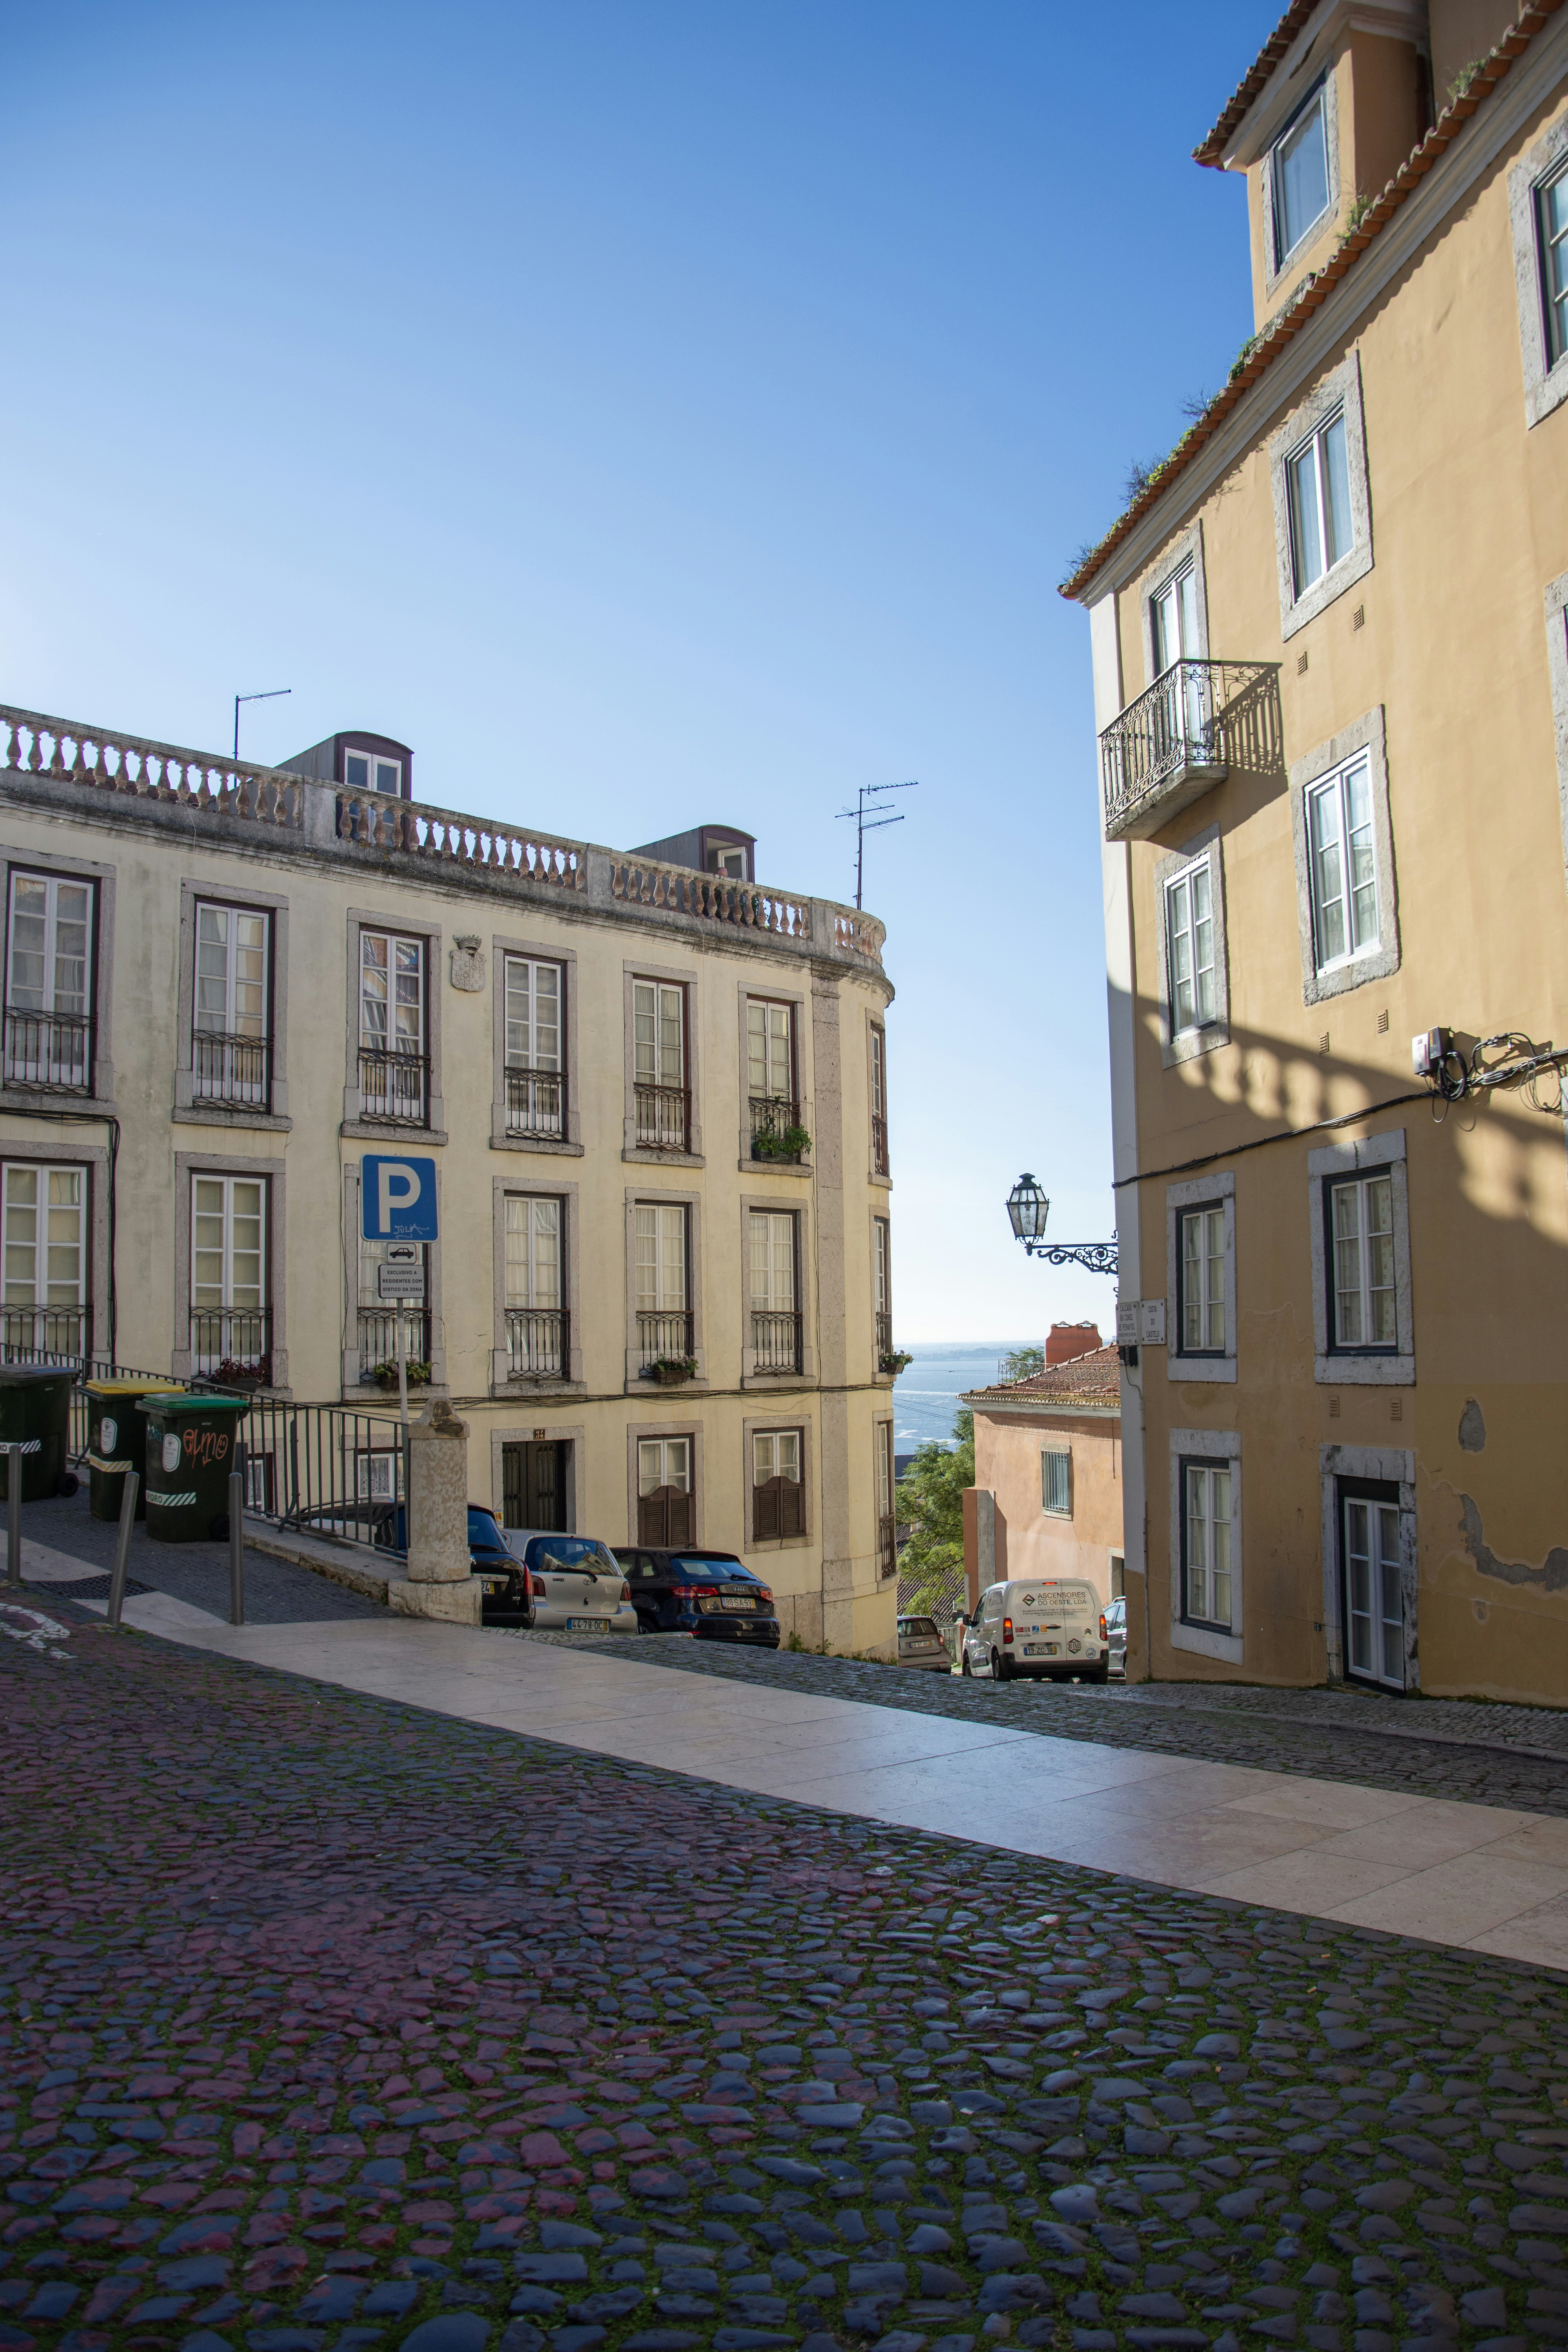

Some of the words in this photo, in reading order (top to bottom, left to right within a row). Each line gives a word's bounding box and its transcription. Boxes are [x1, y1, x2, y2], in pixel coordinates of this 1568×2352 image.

[378, 1163, 421, 1232] P
[535, 1430, 544, 1438] 34
[147, 1492, 162, 1503] VIDRO
